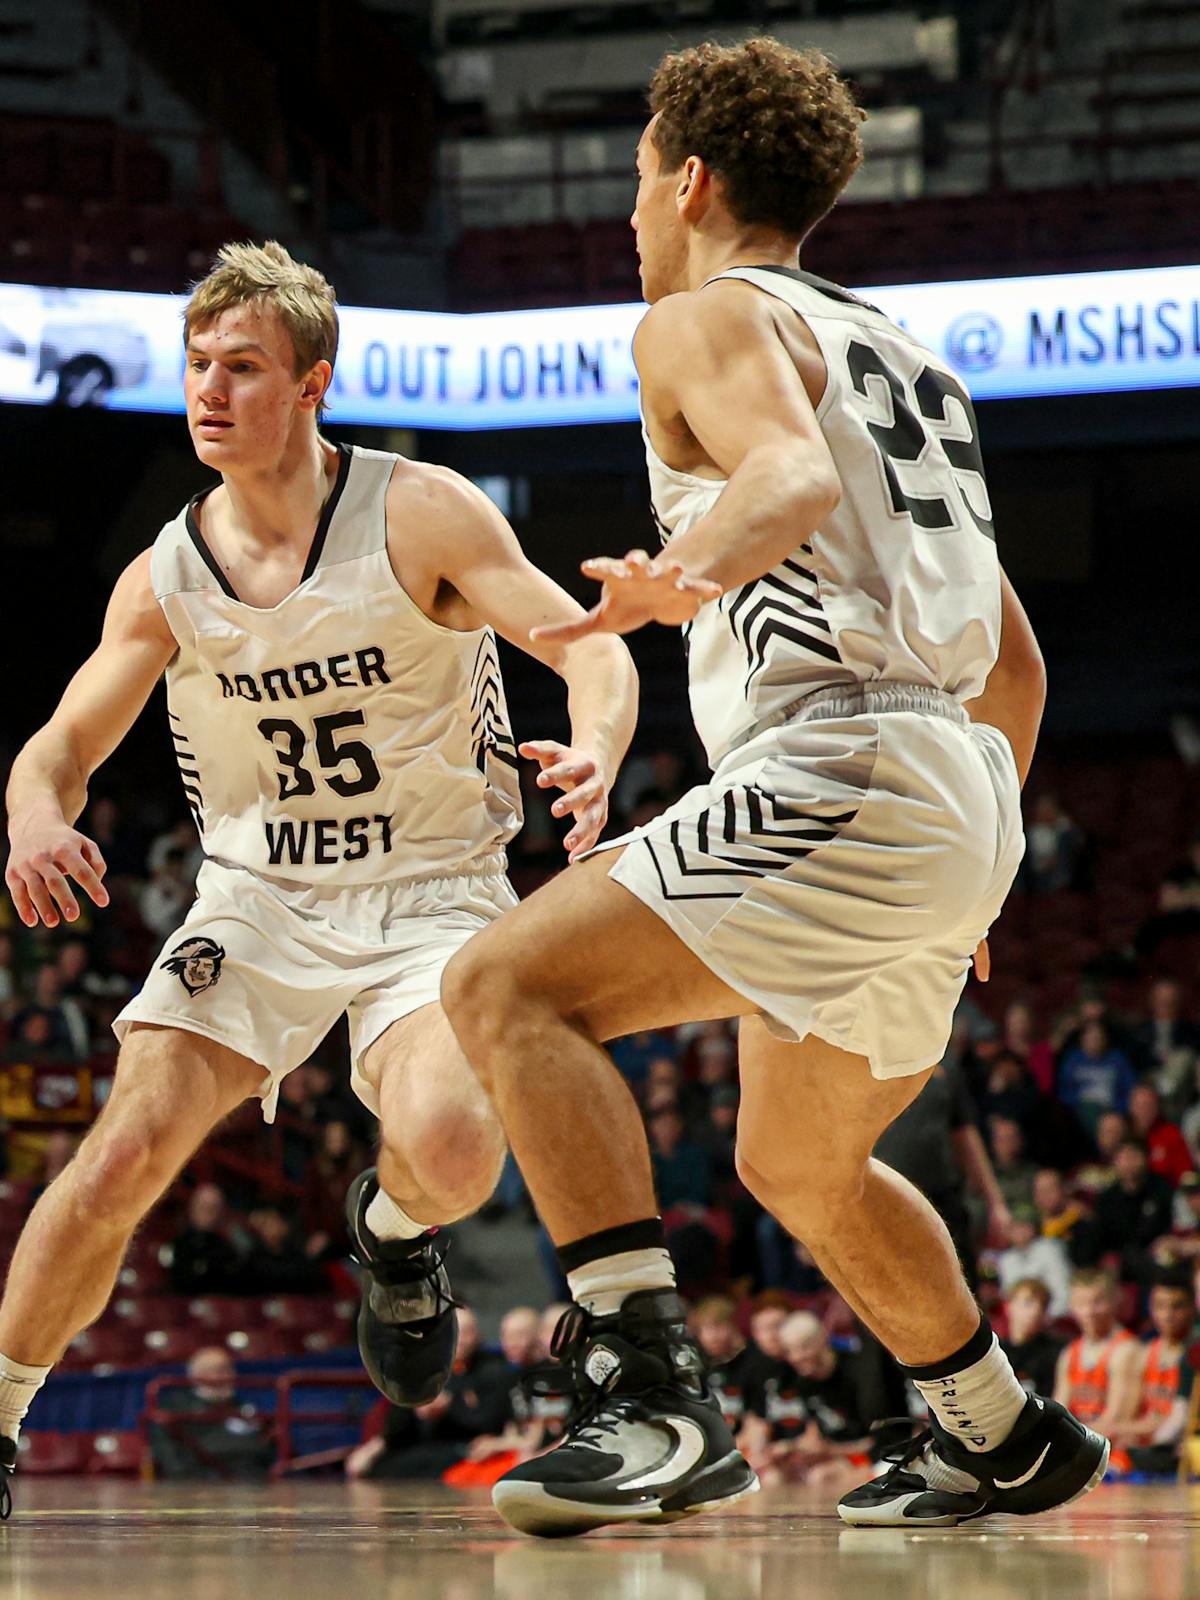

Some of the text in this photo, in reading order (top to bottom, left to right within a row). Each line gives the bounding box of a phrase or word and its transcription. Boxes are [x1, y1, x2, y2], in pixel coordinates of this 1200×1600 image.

[363, 340, 450, 401] OUT
[257, 708, 382, 801] 35
[265, 811, 397, 865] WEST
